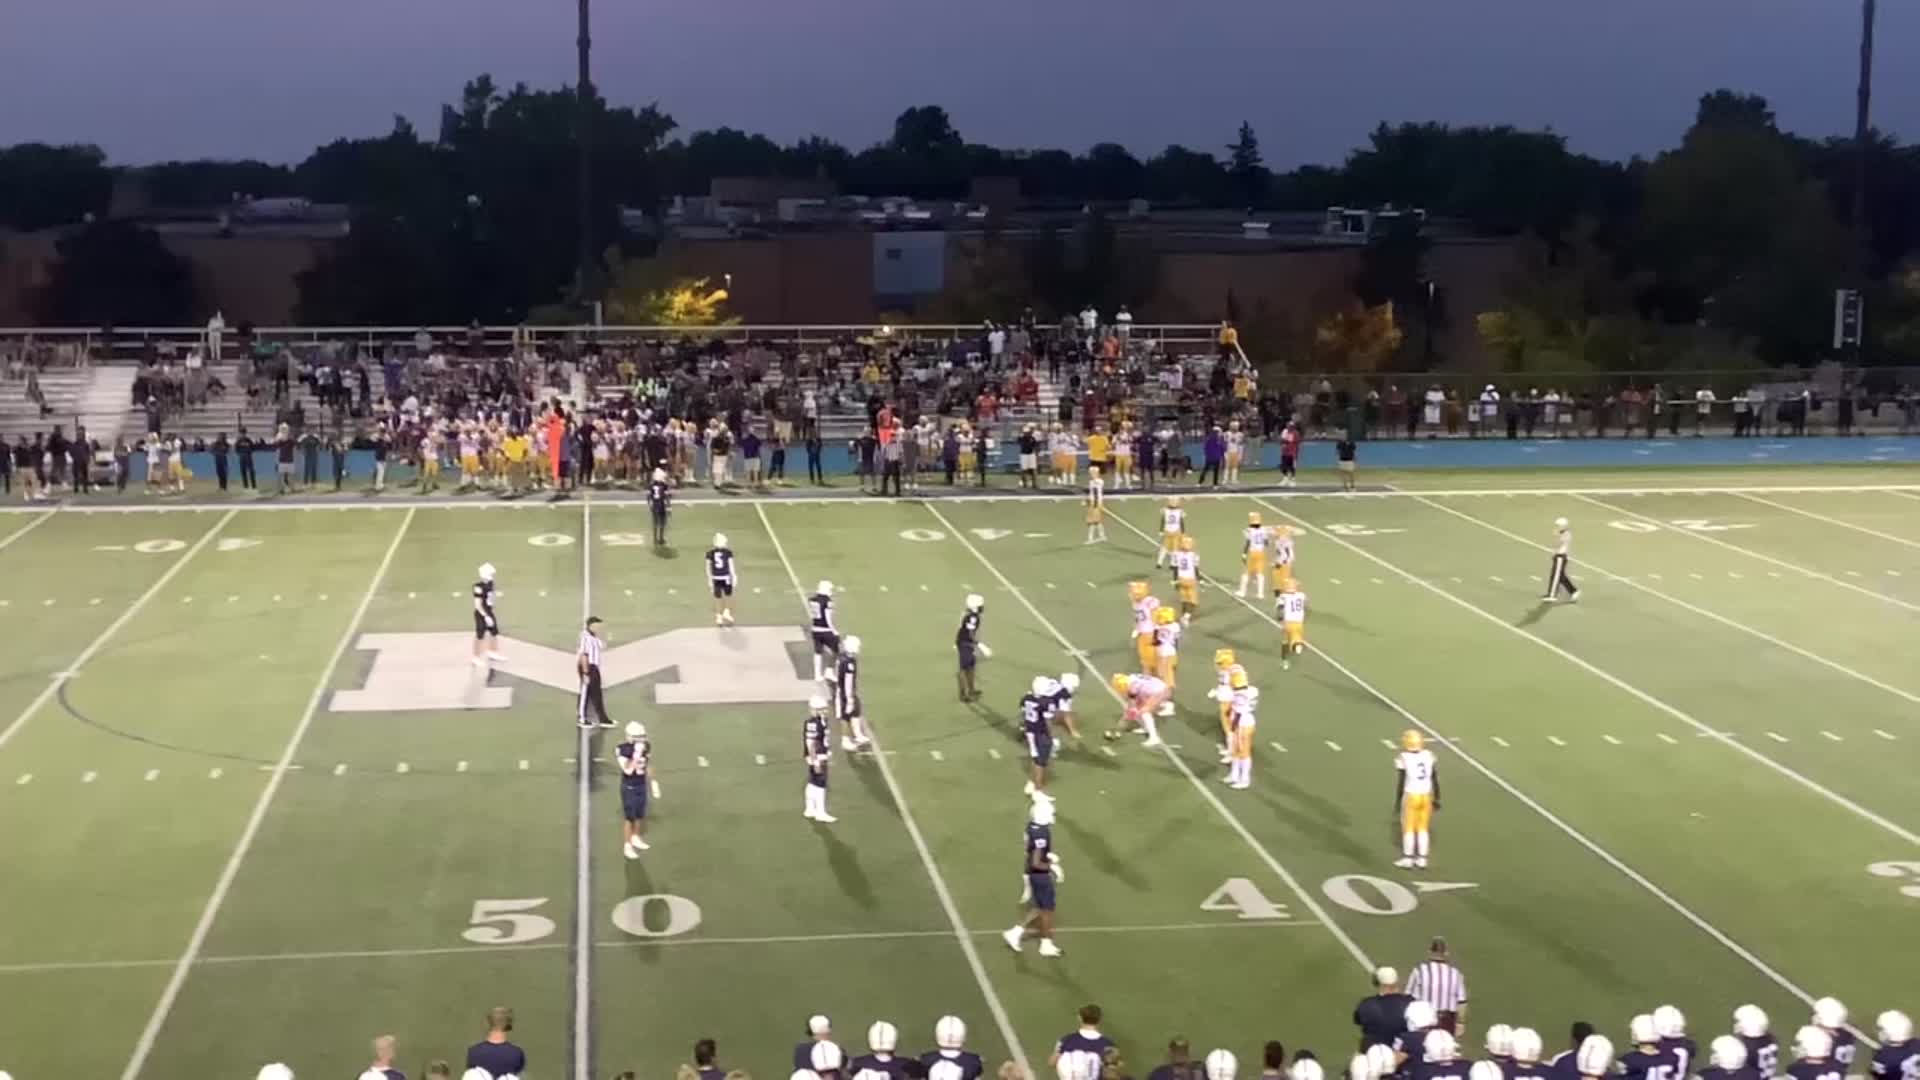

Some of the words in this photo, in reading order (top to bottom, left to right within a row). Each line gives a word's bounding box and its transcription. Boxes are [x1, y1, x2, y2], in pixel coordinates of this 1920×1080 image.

[714, 552, 724, 568] 5
[1290, 598, 1302, 612] 18
[328, 626, 816, 711] M
[1416, 761, 1427, 781] 3
[1200, 874, 1418, 918] 40
[461, 894, 702, 943] 50
